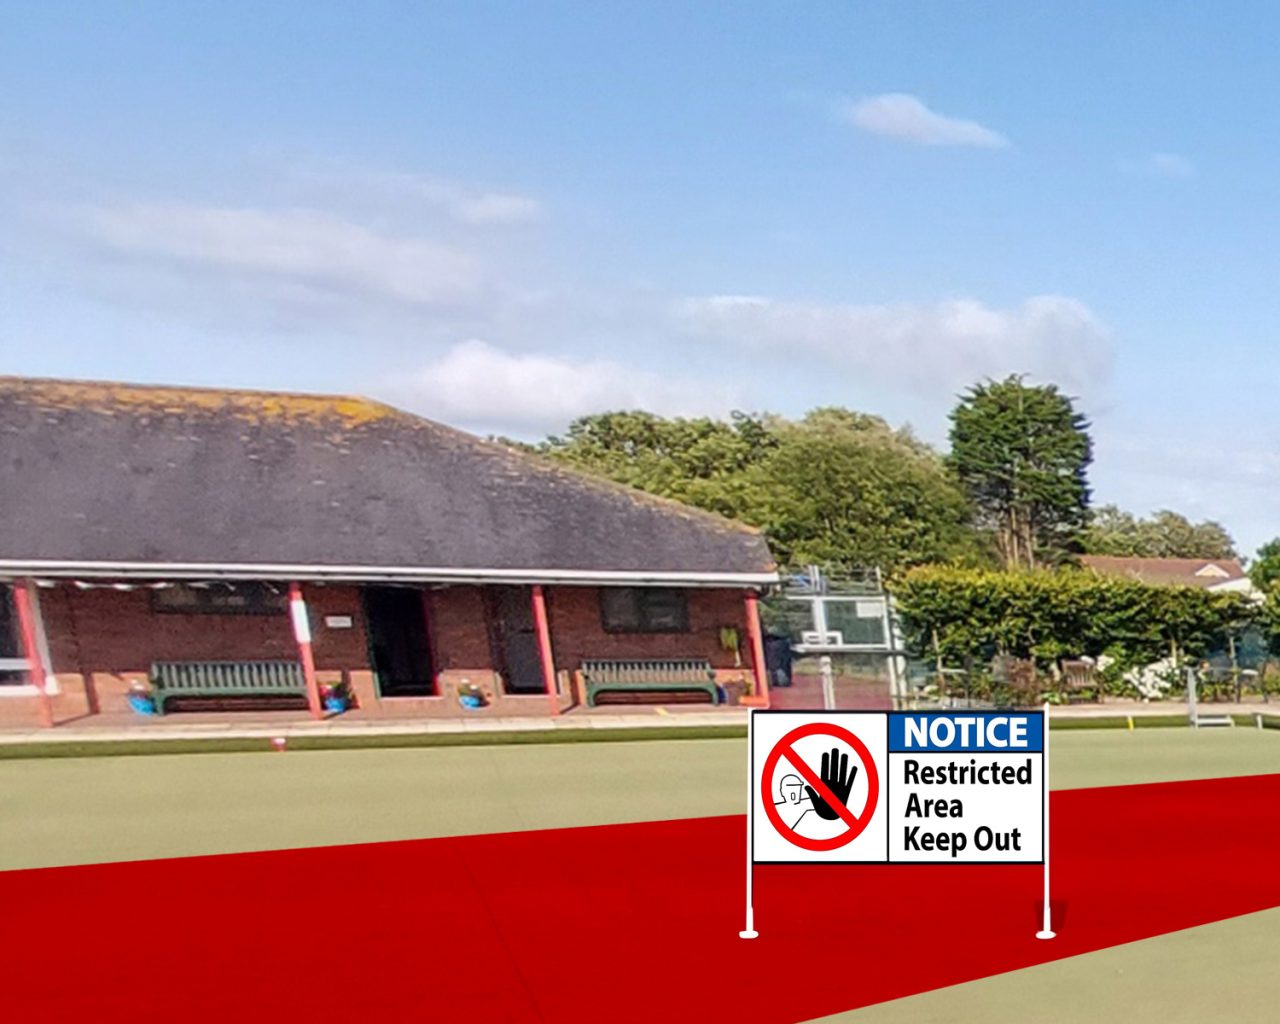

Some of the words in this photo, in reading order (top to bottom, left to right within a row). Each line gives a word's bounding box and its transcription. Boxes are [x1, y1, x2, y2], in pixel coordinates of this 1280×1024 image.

[905, 717, 1027, 747] NOTICE
[905, 759, 1031, 784] Restricted
[905, 793, 962, 818] Area
[905, 826, 967, 857] Keep
[974, 826, 1021, 851] Out
